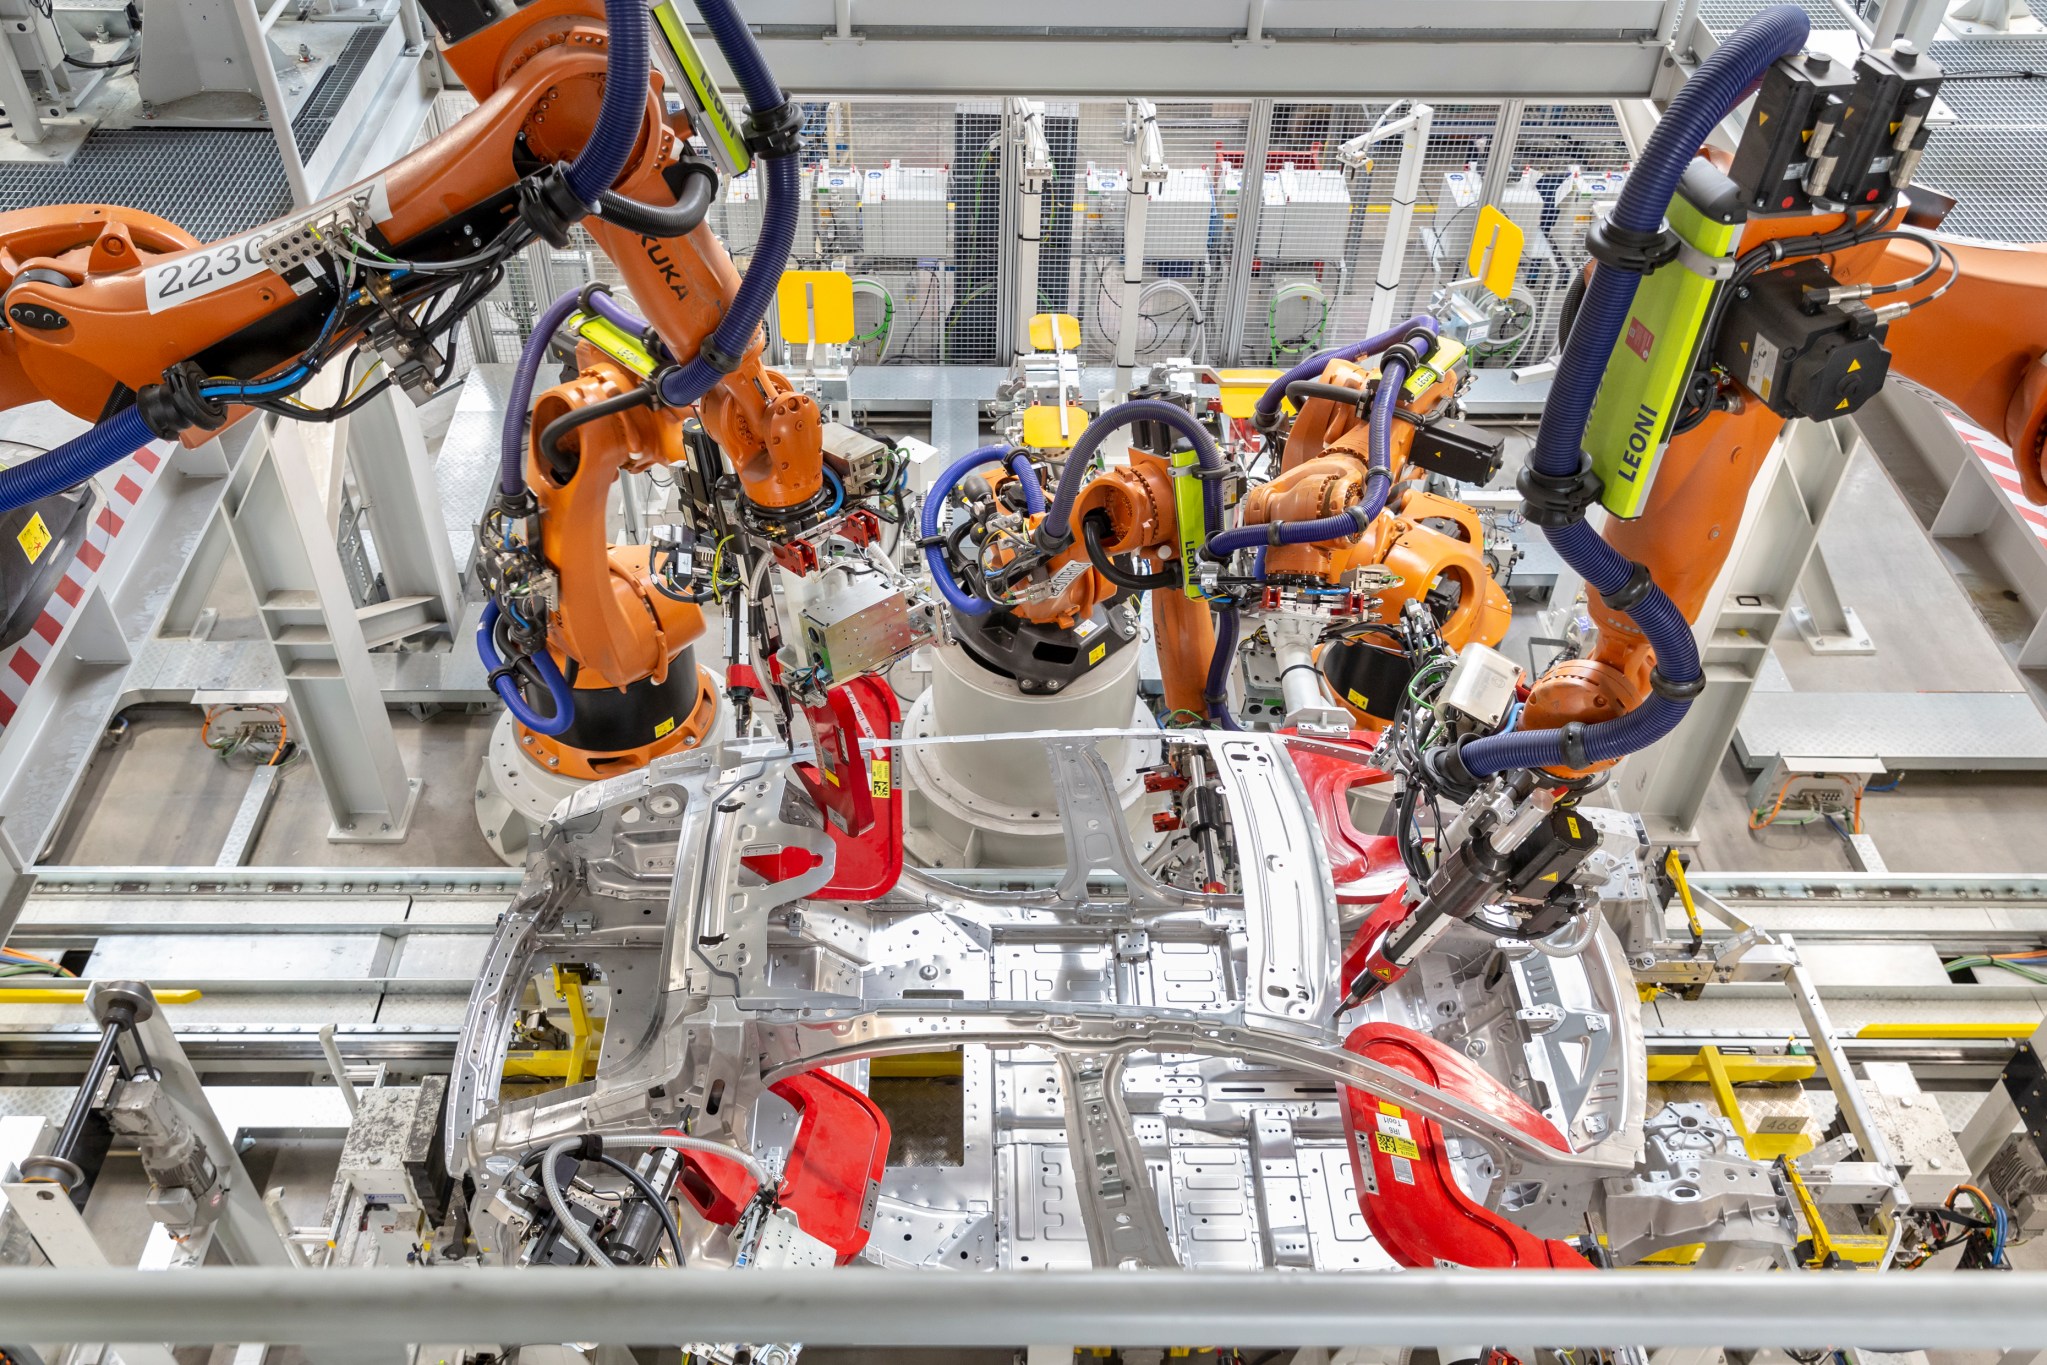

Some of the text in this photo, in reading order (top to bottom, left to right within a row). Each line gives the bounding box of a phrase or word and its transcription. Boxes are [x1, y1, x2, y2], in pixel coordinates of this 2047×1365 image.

[700, 71, 735, 139] LEONI
[635, 232, 689, 301] KUKA
[1618, 403, 1659, 483] LEONI
[1766, 1120, 1799, 1131] 466
